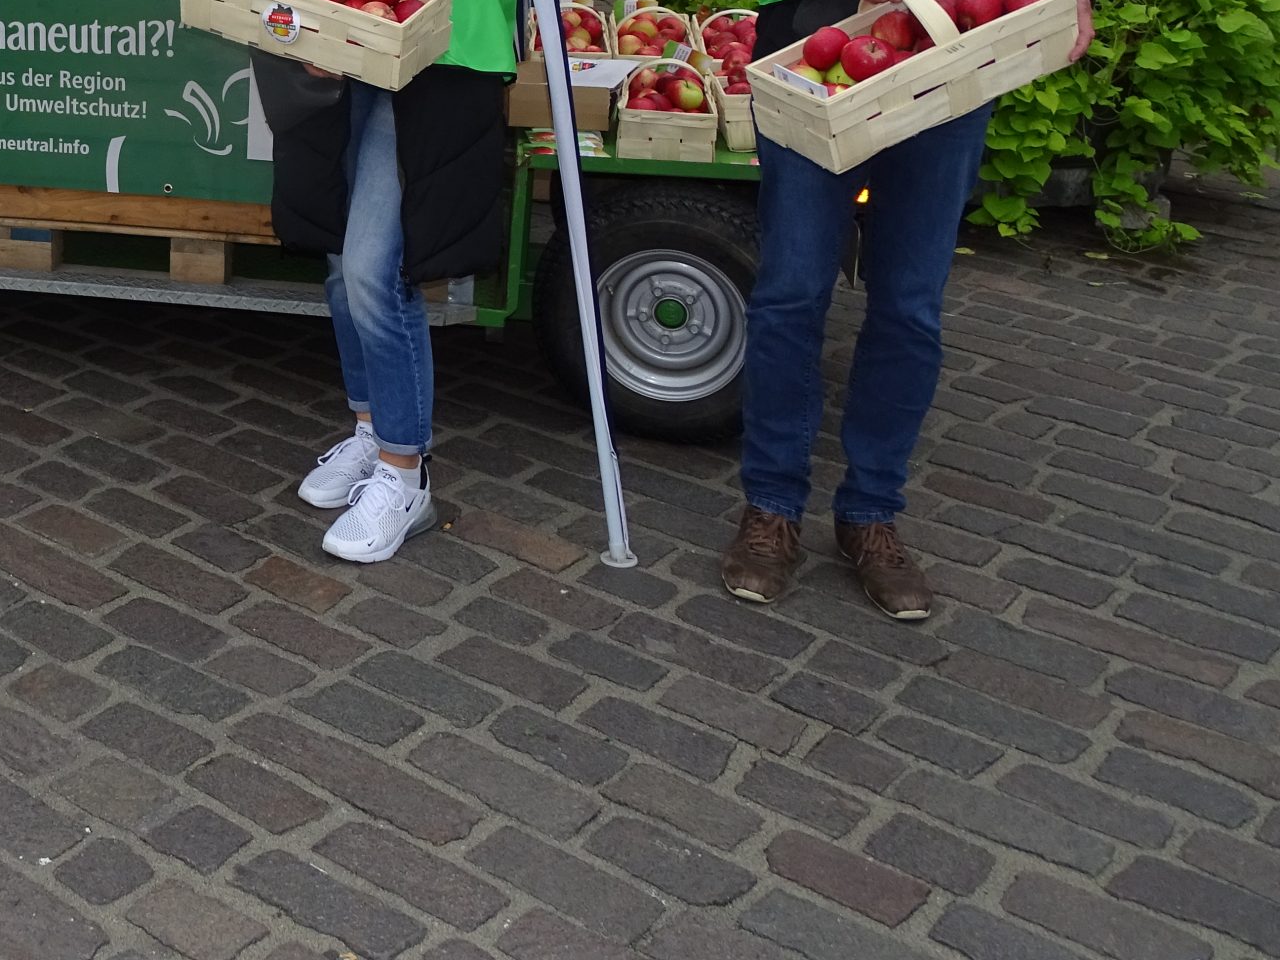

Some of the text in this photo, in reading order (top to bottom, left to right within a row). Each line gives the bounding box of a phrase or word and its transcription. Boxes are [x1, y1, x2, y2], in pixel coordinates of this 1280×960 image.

[21, 67, 53, 87] der
[59, 70, 126, 95] Region
[5, 93, 148, 119] Umweltschutz!
